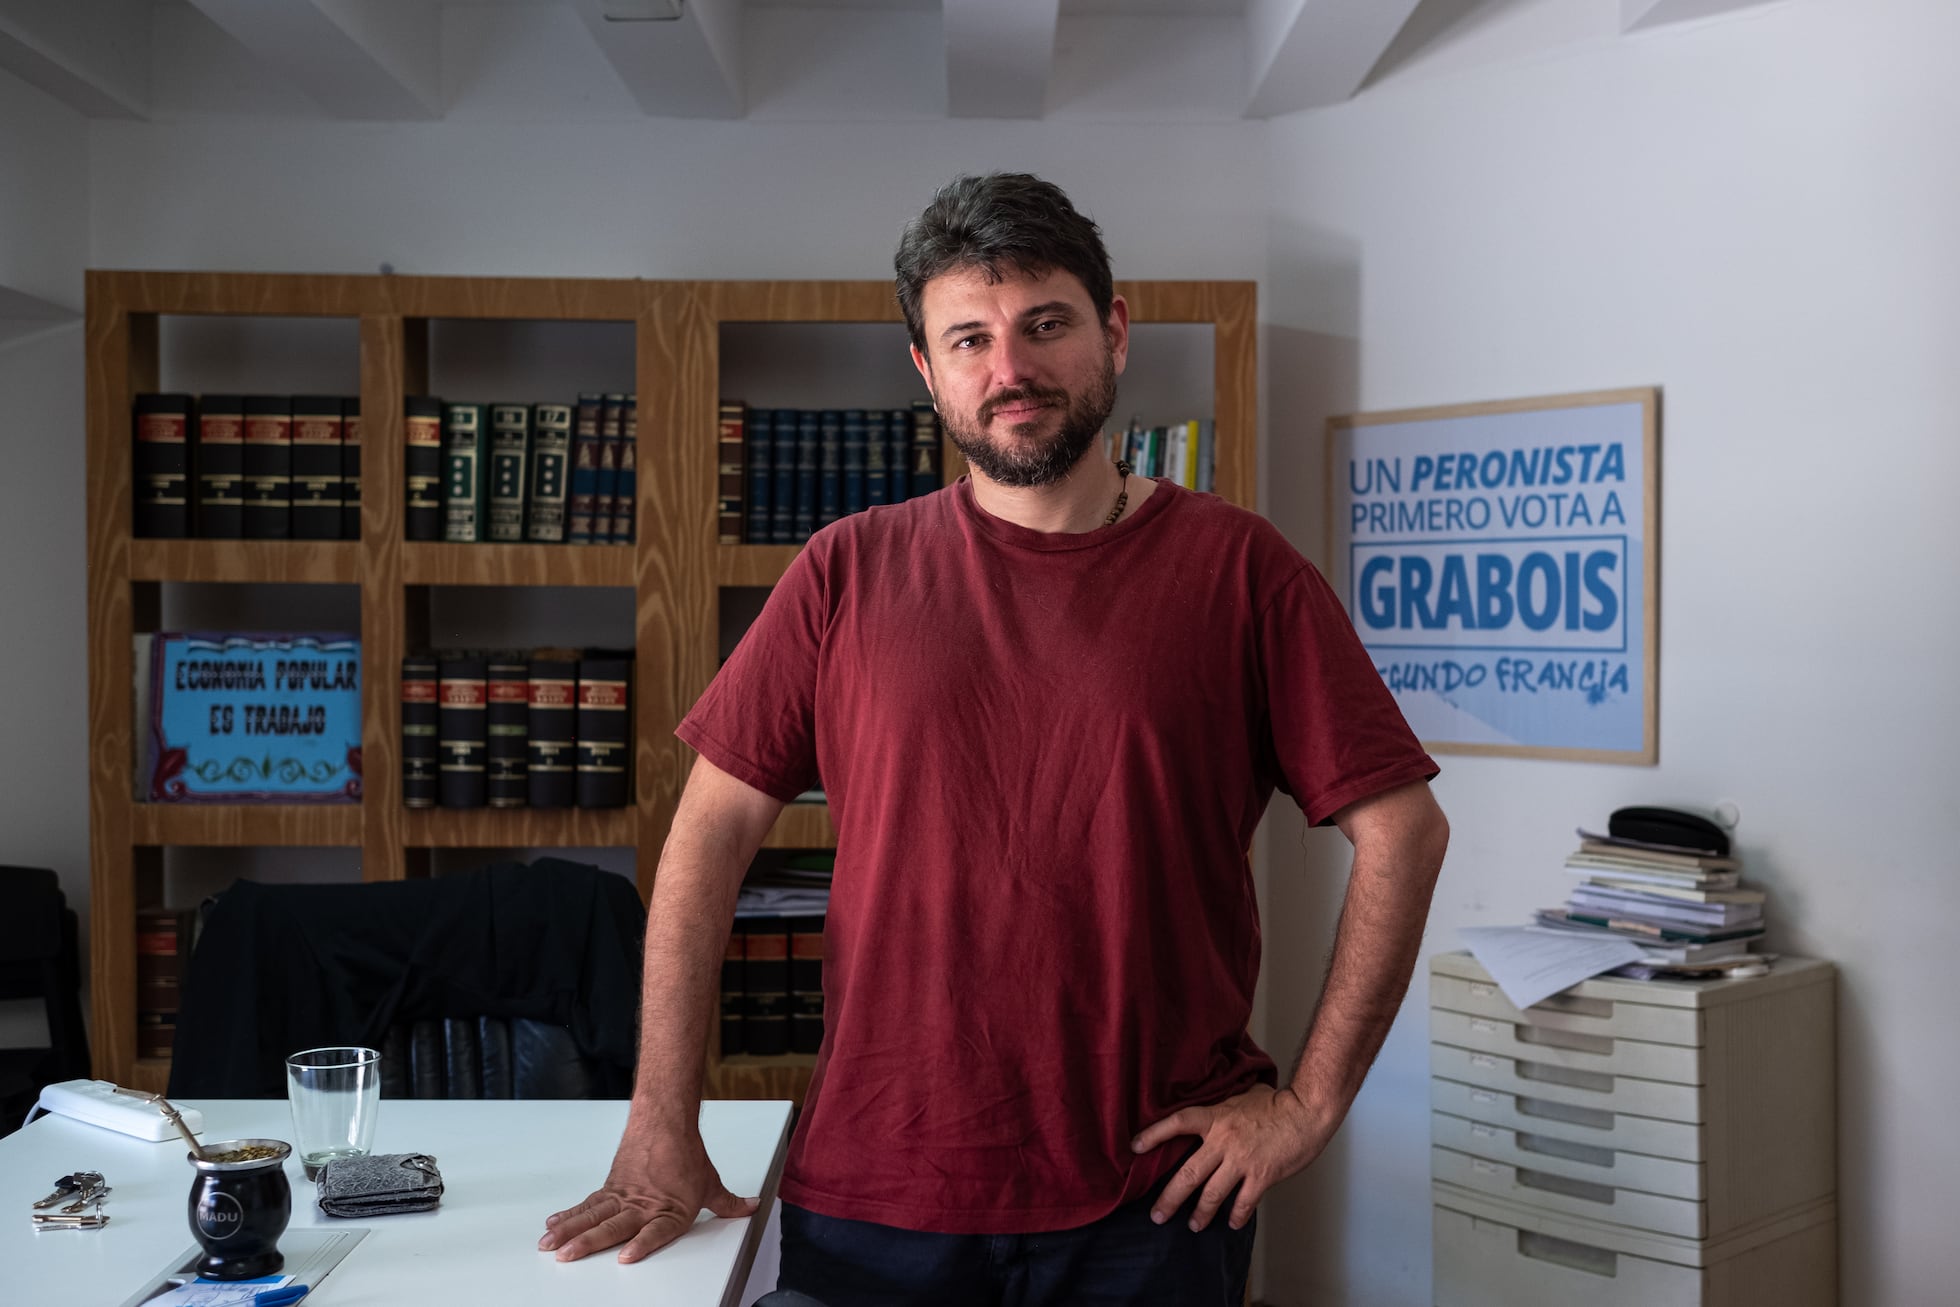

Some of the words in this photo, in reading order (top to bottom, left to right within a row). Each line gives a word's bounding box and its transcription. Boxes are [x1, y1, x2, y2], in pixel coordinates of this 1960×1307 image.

[1349, 457, 1400, 496] UN
[1410, 442, 1626, 493] PERONISTA
[1350, 495, 1491, 534] PRIMERO
[1497, 491, 1593, 529] VOTA
[1600, 490, 1626, 526] A
[1358, 549, 1619, 633] GRABOIS
[175, 661, 266, 691] ECONOMIA
[275, 660, 358, 690] POPULAR
[1379, 659, 1487, 694] GUNDO
[209, 704, 235, 735] ES
[243, 704, 327, 735] TRABAJO
[200, 1211, 238, 1223] MADU
